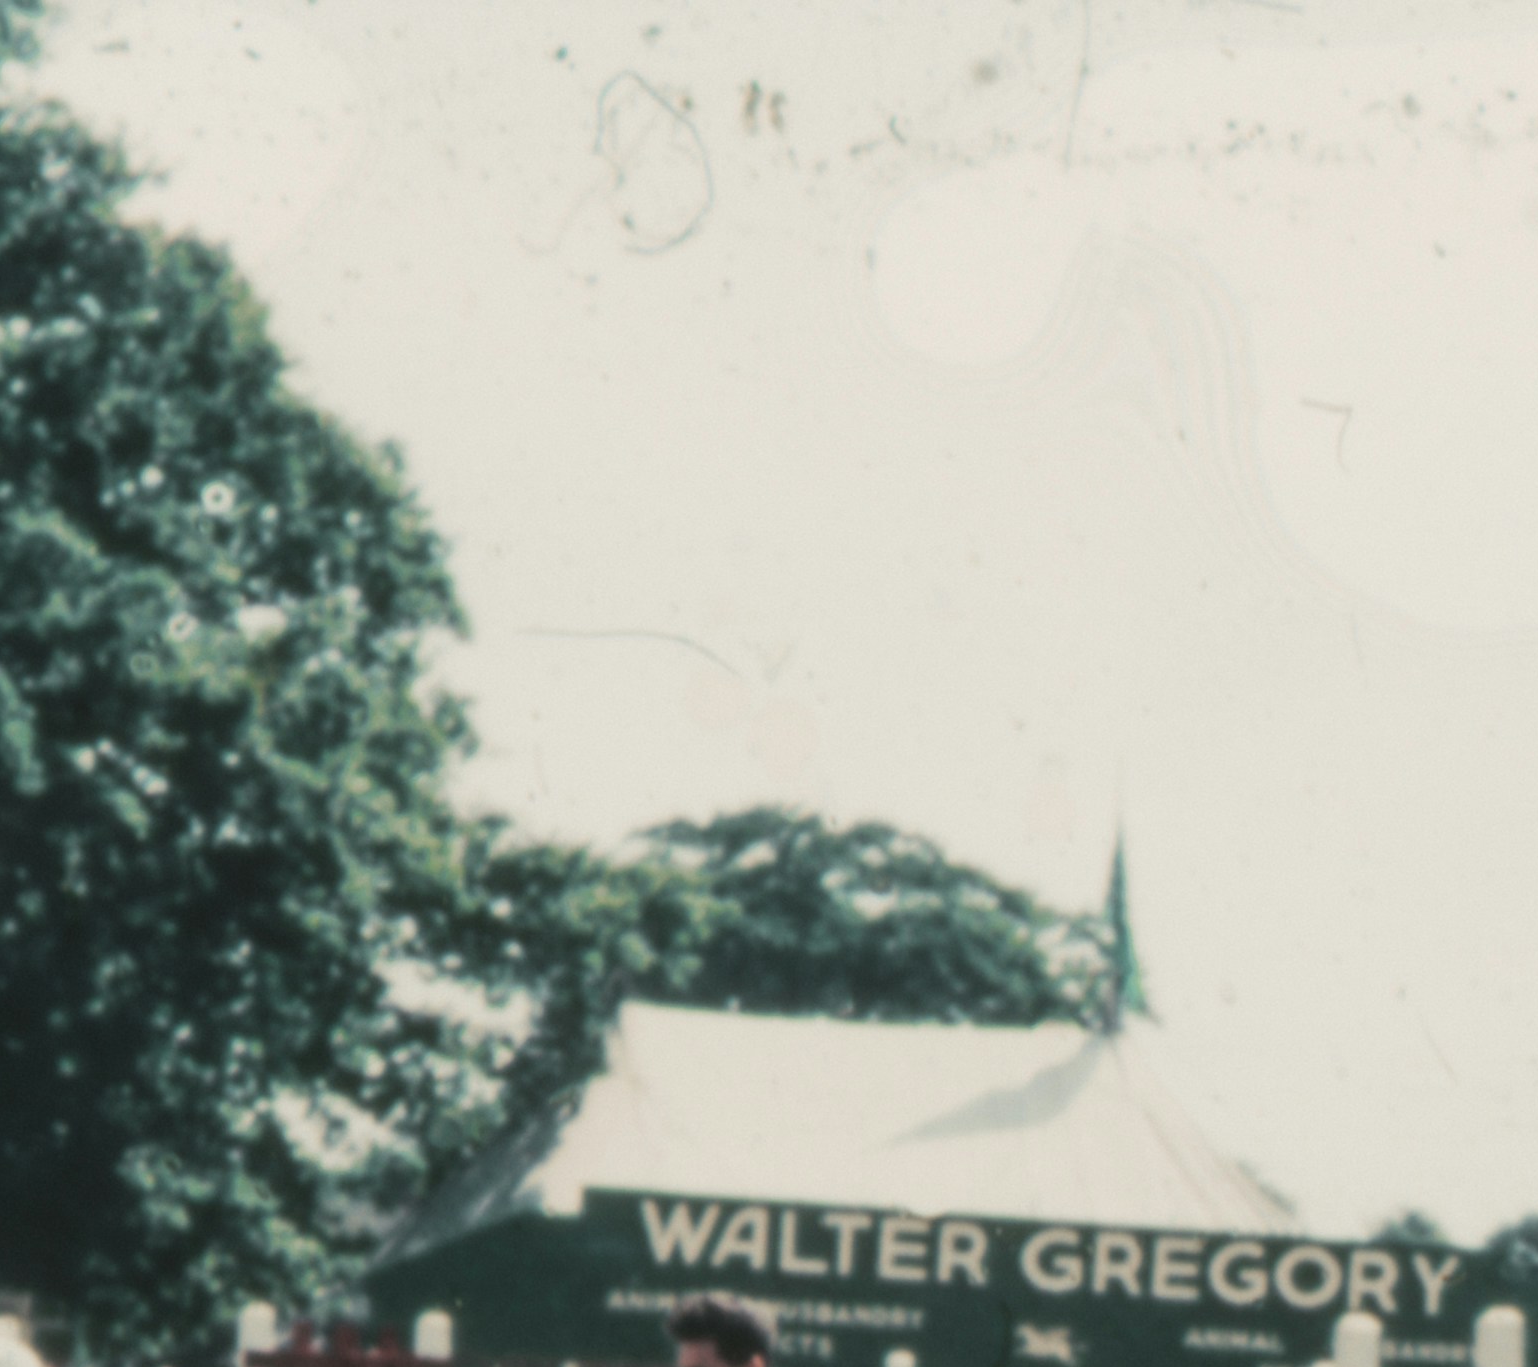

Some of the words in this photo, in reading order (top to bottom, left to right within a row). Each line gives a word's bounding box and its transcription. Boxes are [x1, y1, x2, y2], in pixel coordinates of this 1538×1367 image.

[640, 1199, 988, 1286] WALTER
[1020, 1227, 1460, 1317] GREGORY
[768, 1300, 925, 1330] USBANDRY
